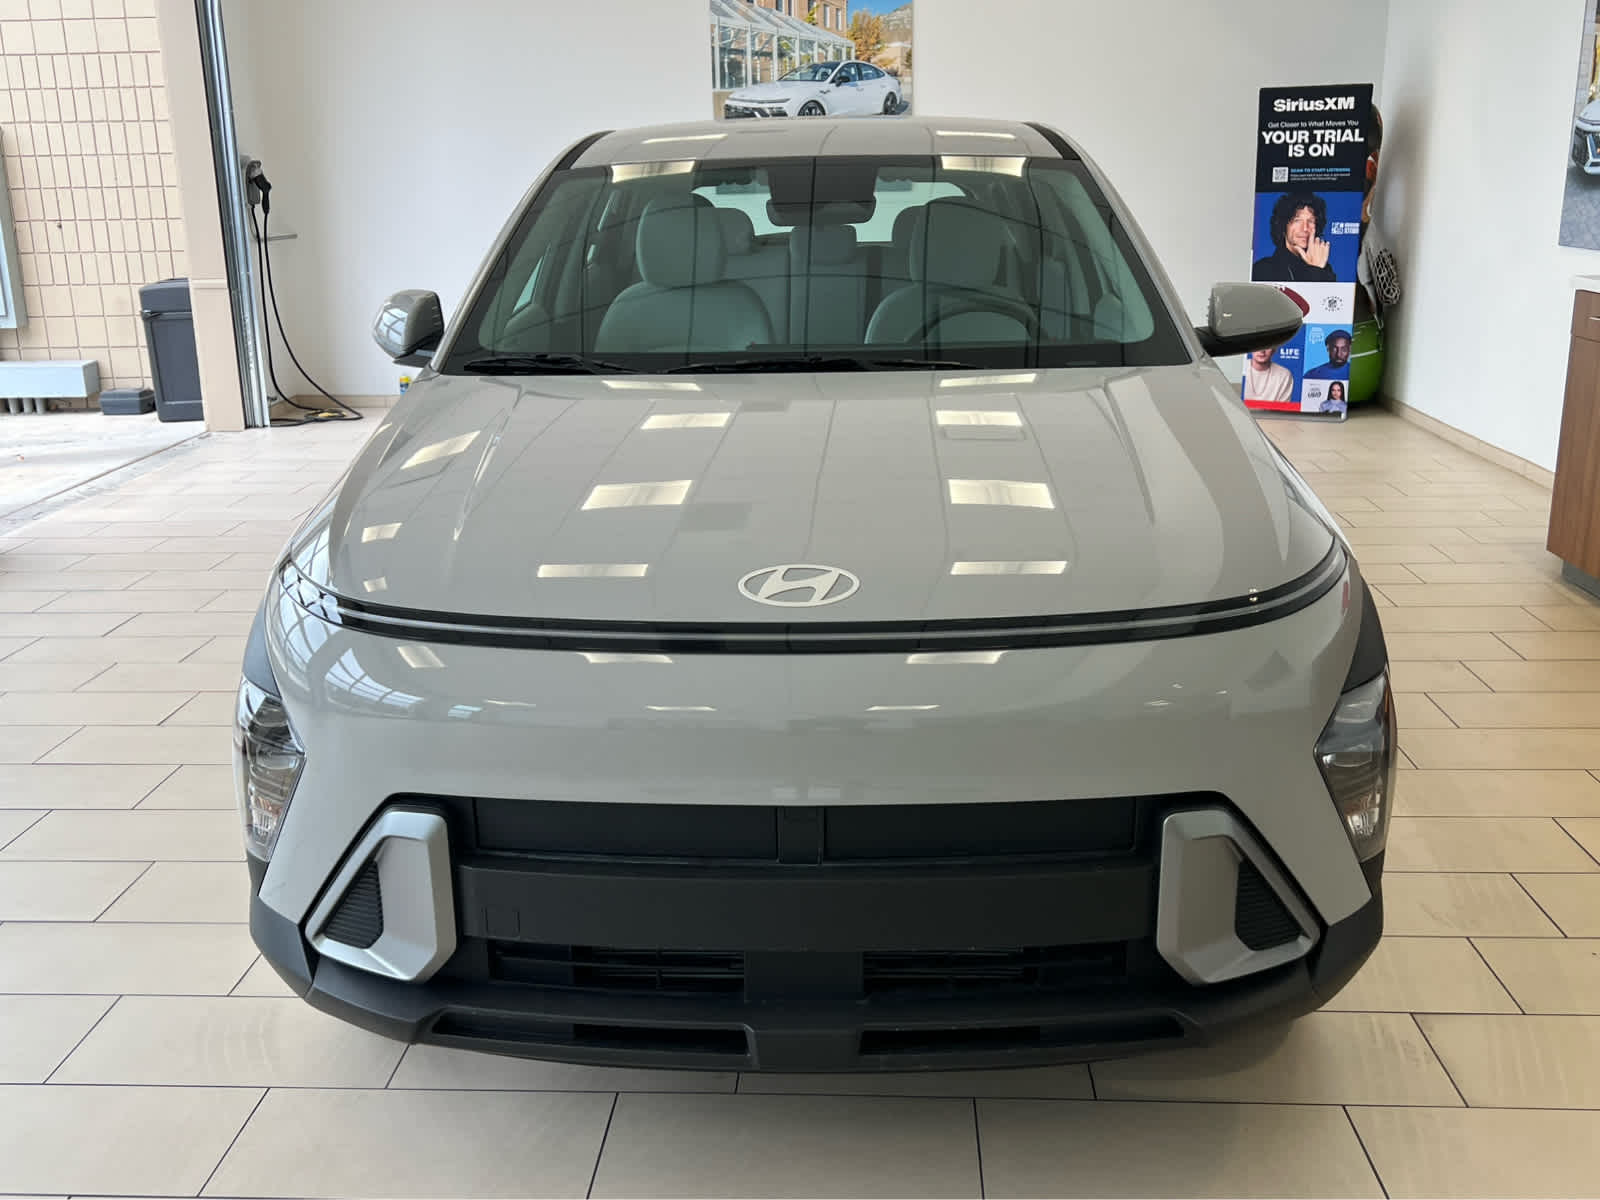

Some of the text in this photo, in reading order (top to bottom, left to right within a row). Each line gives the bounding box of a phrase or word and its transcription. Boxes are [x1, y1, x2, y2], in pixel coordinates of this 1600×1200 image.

[1273, 96, 1355, 112] SiriusXM
[1262, 129, 1364, 144] YOUR TRIAL
[1288, 143, 1335, 157] IS ON
[1280, 348, 1300, 356] LIFE
